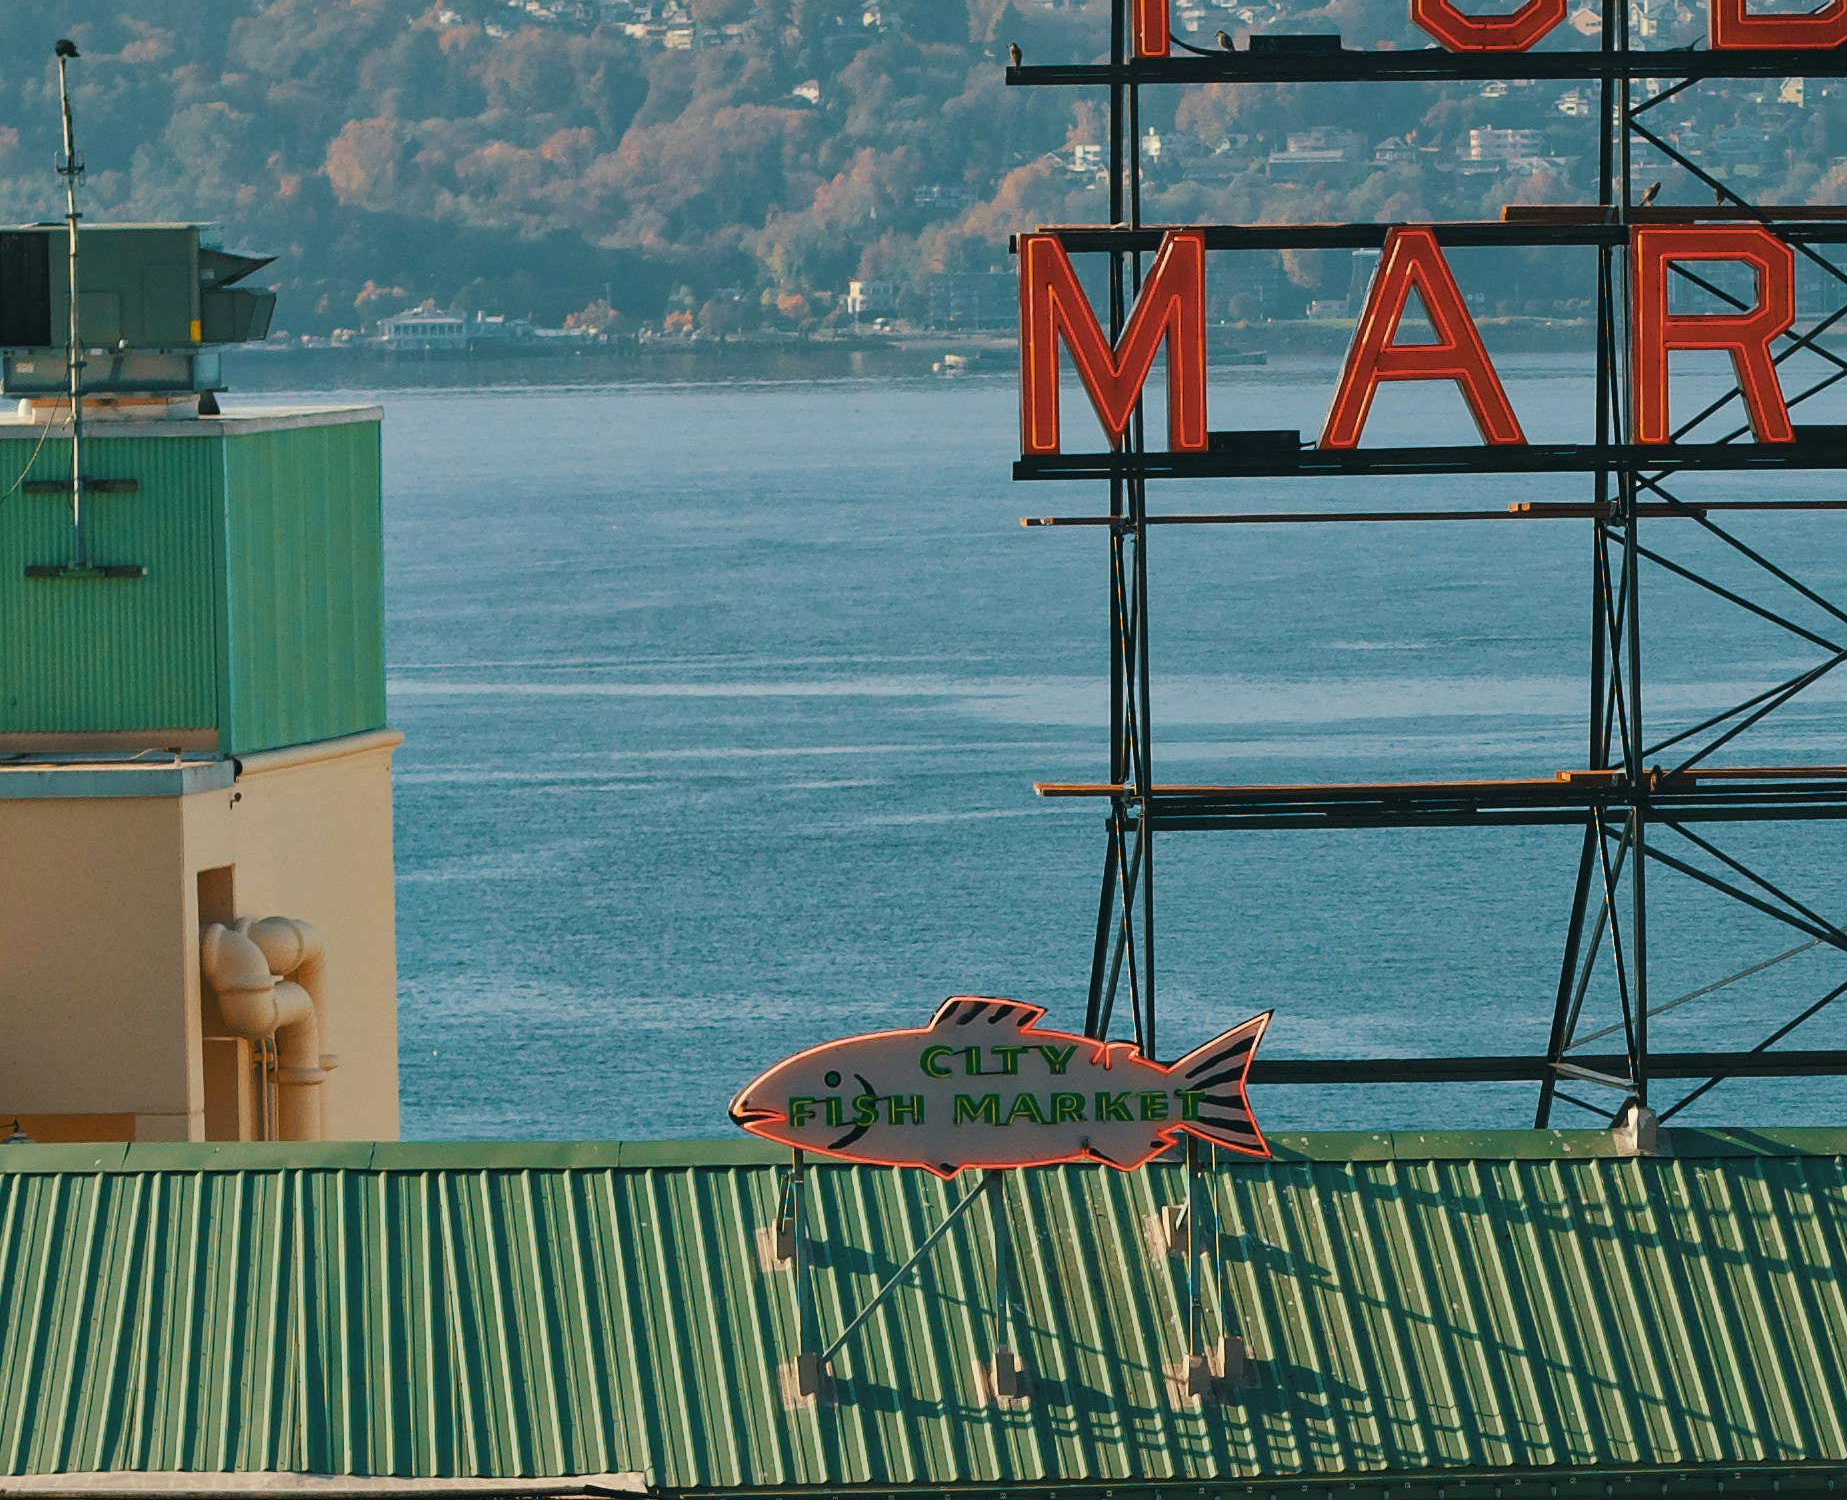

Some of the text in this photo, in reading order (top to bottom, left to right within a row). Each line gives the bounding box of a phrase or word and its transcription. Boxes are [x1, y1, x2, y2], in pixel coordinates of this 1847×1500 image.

[919, 1045, 1078, 1078] CITY
[788, 1090, 1207, 1128] FISH MARKET
